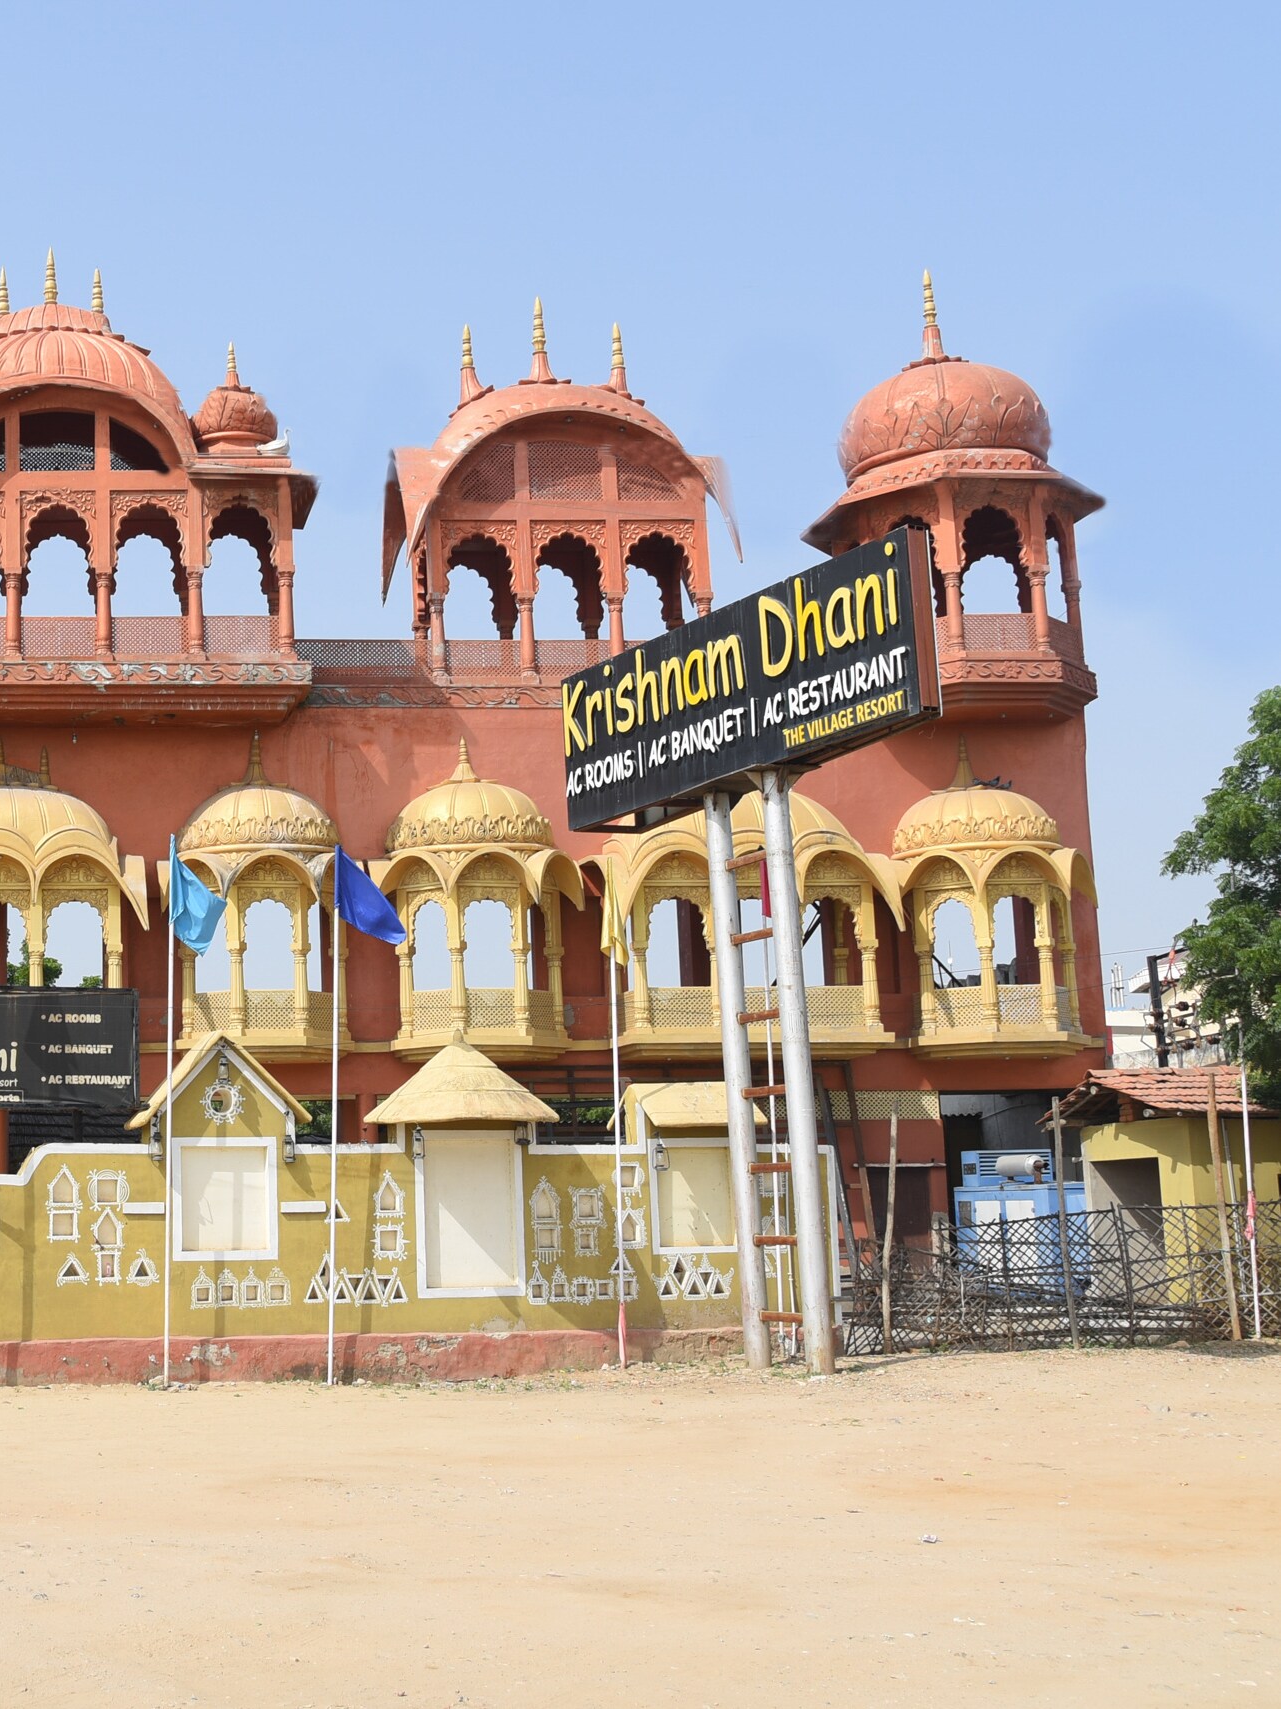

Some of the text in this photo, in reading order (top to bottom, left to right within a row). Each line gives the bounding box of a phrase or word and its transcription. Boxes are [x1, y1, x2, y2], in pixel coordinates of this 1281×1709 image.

[562, 541, 898, 757] Krishnam Dhani
[566, 767, 583, 798] AC
[585, 749, 634, 791] ROOMS
[648, 735, 667, 768] AC
[671, 707, 744, 761] BANQUET
[763, 692, 784, 728] AC
[788, 646, 907, 719] RESTAURANT
[782, 690, 904, 748] THE VILLAGE RESORT
[48, 1013, 102, 1023] AC ROOMS
[48, 1044, 113, 1054] AC BANQUET
[48, 1075, 132, 1085] AC RESTAURANT
